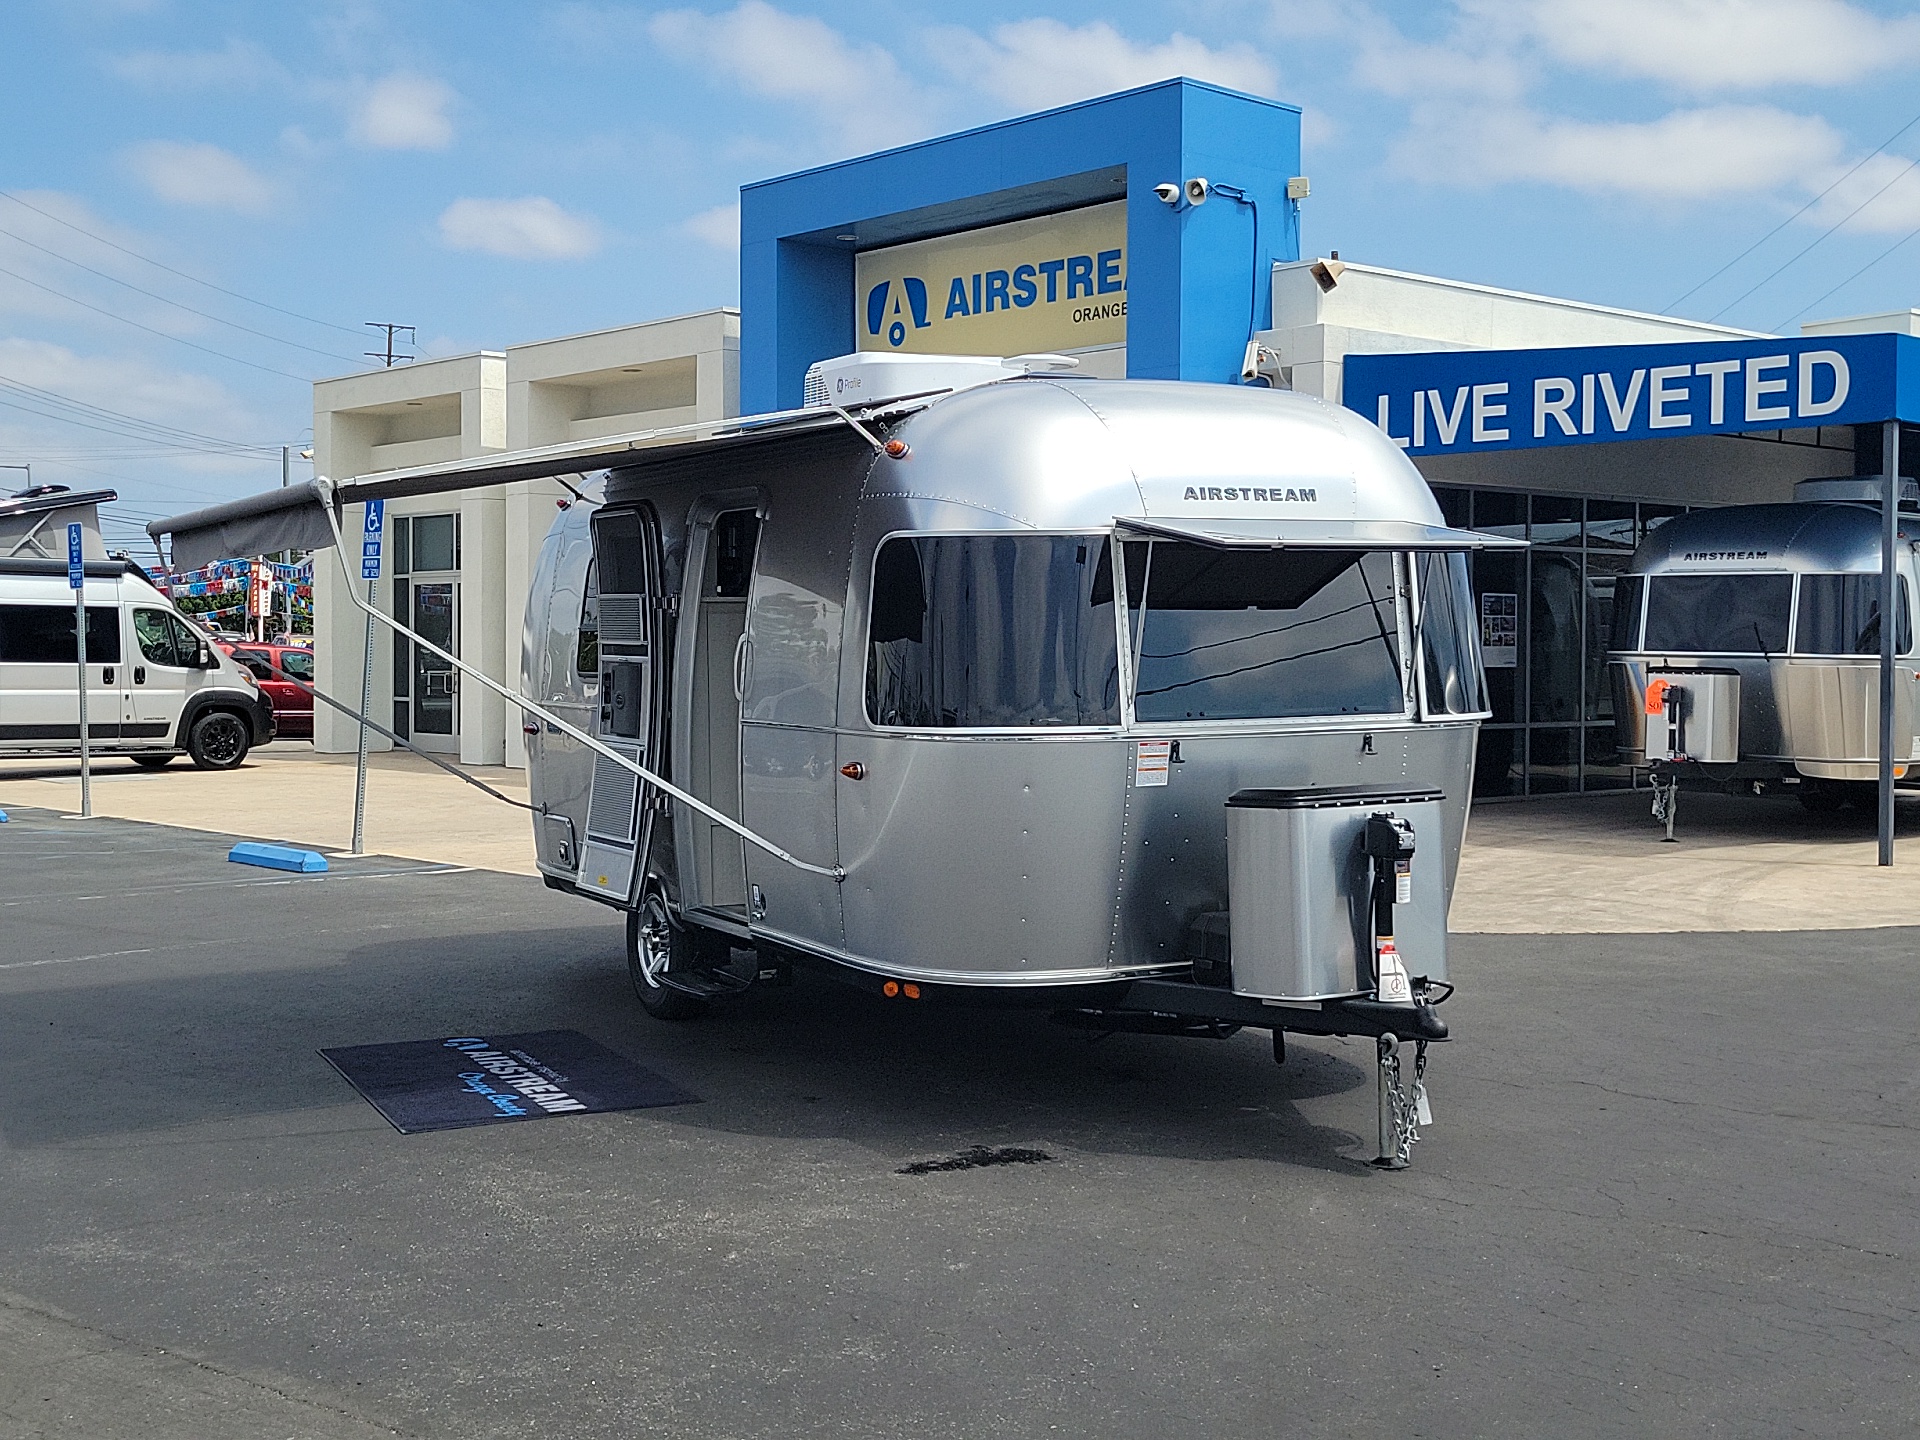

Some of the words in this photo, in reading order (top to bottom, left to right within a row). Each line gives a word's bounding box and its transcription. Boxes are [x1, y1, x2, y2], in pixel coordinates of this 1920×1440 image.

[945, 249, 1127, 319] AIRSTRE
[1073, 302, 1127, 323] ORANGE
[1378, 382, 1510, 448] LIVE
[1534, 350, 1850, 438] RIVETED
[1184, 486, 1317, 502] AIRSTREAM
[366, 544, 378, 555] ONLY
[1683, 551, 1768, 561] AIRSTREAM
[464, 1051, 587, 1113] AIRSTREAM
